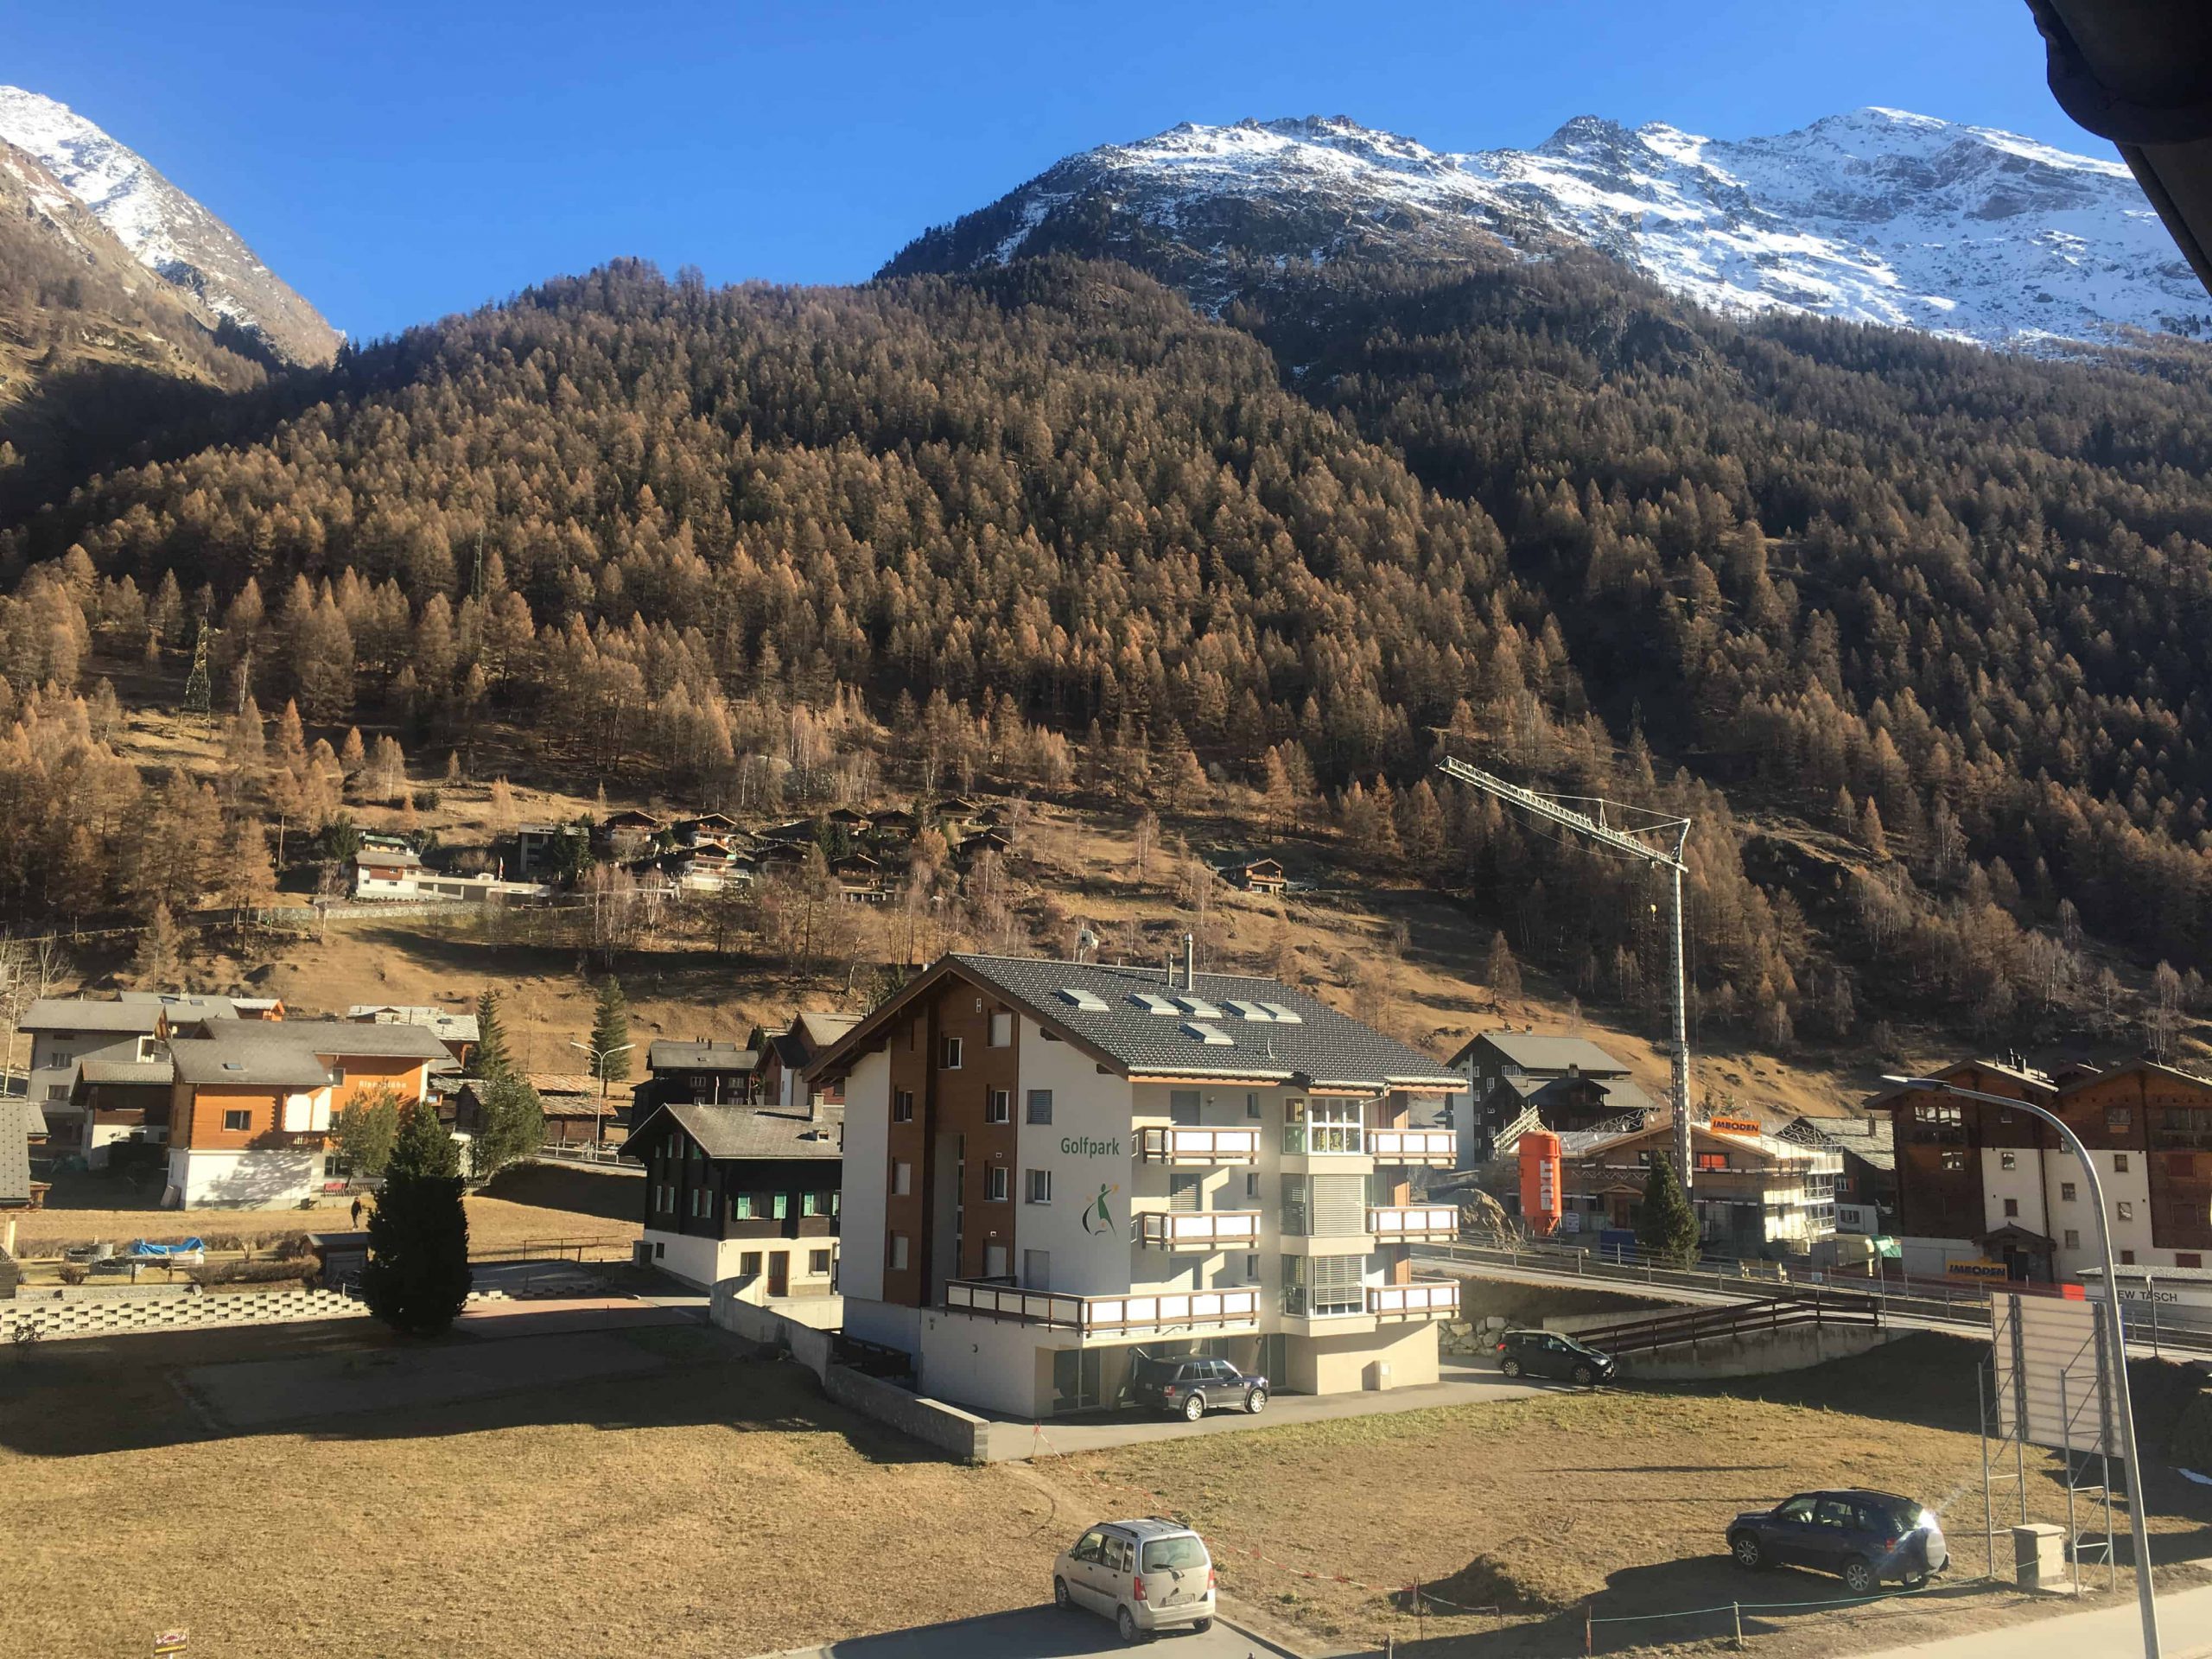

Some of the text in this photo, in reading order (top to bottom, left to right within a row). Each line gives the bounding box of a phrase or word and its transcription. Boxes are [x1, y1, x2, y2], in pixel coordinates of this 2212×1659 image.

[1713, 1121, 1759, 1133] IMBODEN
[1061, 1136, 1120, 1159] Golfpark
[1540, 1160, 1554, 1210] FIXIT
[1949, 1265, 2005, 1275] IMBODEN
